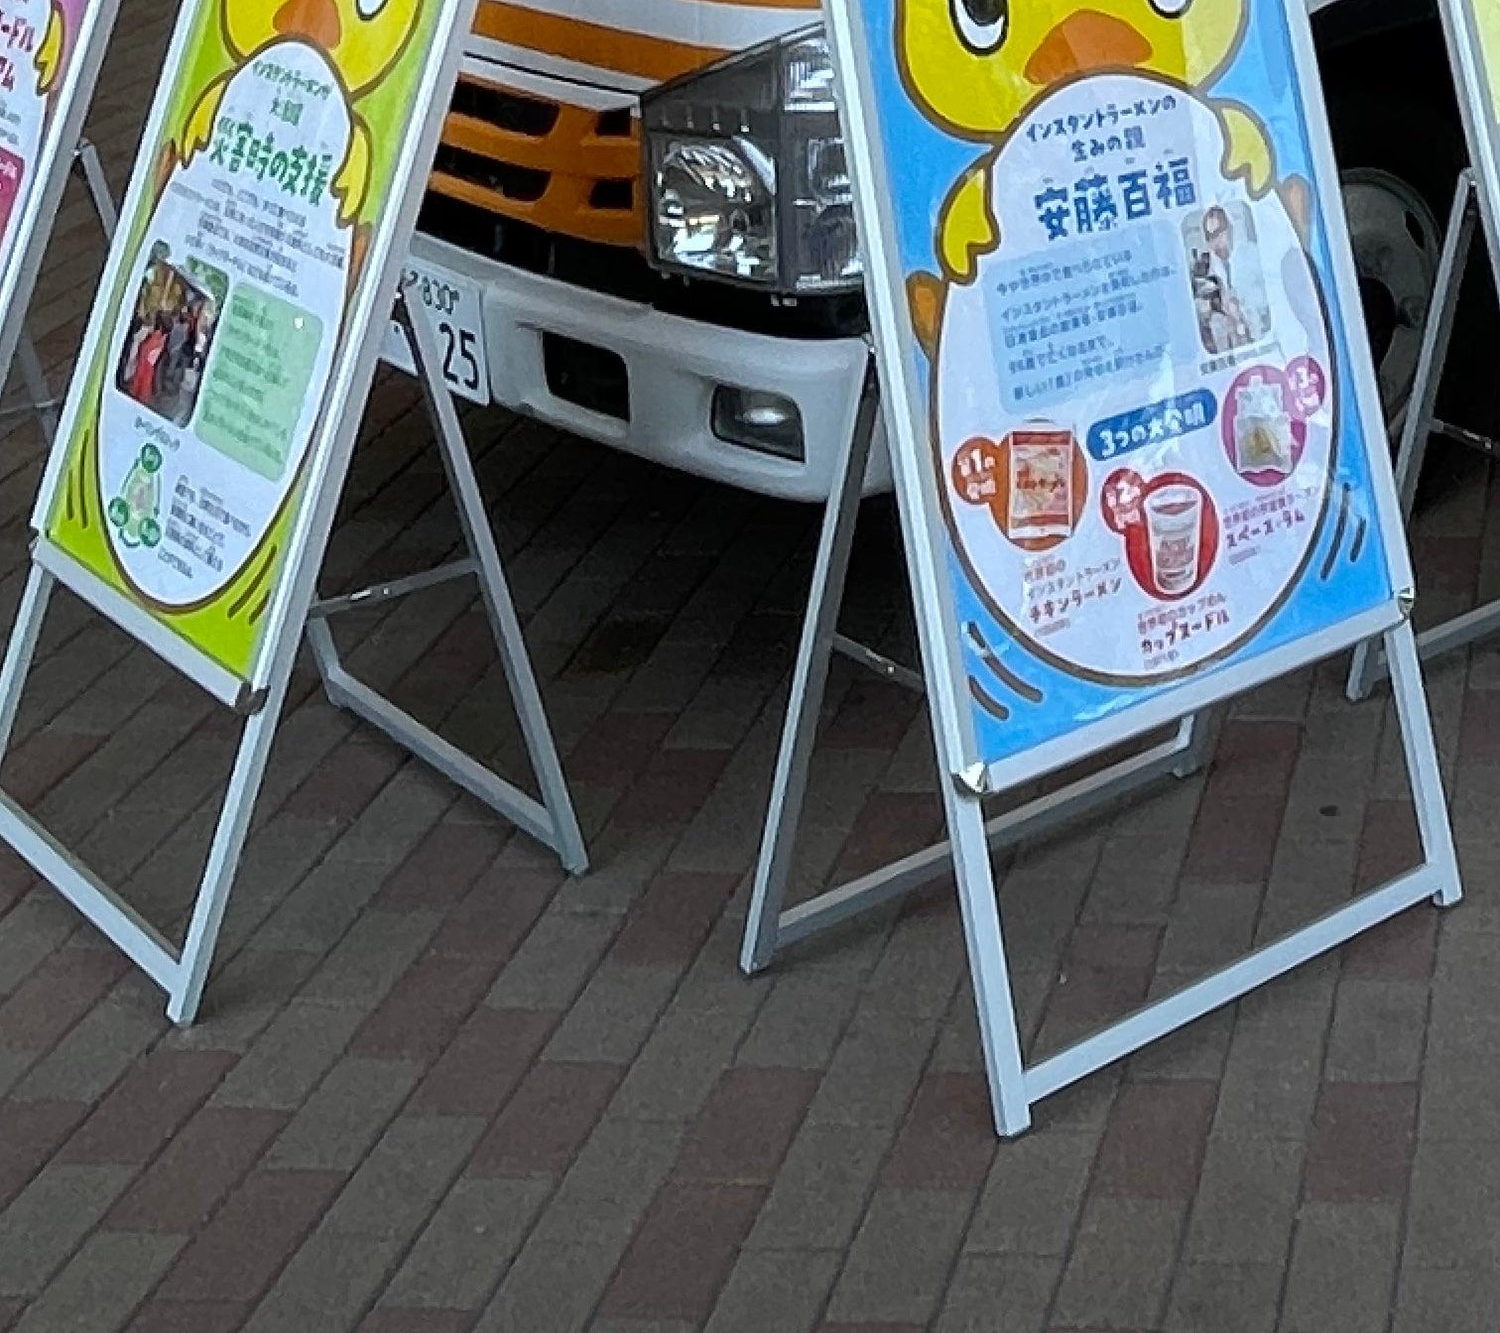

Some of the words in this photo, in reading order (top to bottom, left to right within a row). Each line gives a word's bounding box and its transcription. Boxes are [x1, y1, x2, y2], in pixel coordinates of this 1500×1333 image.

[1026, 94, 1178, 143] インスタントラーメンの
[1070, 124, 1147, 163] 生みの親
[1034, 155, 1197, 241] 安藤百福
[1028, 578, 1124, 625] チキンラーメン
